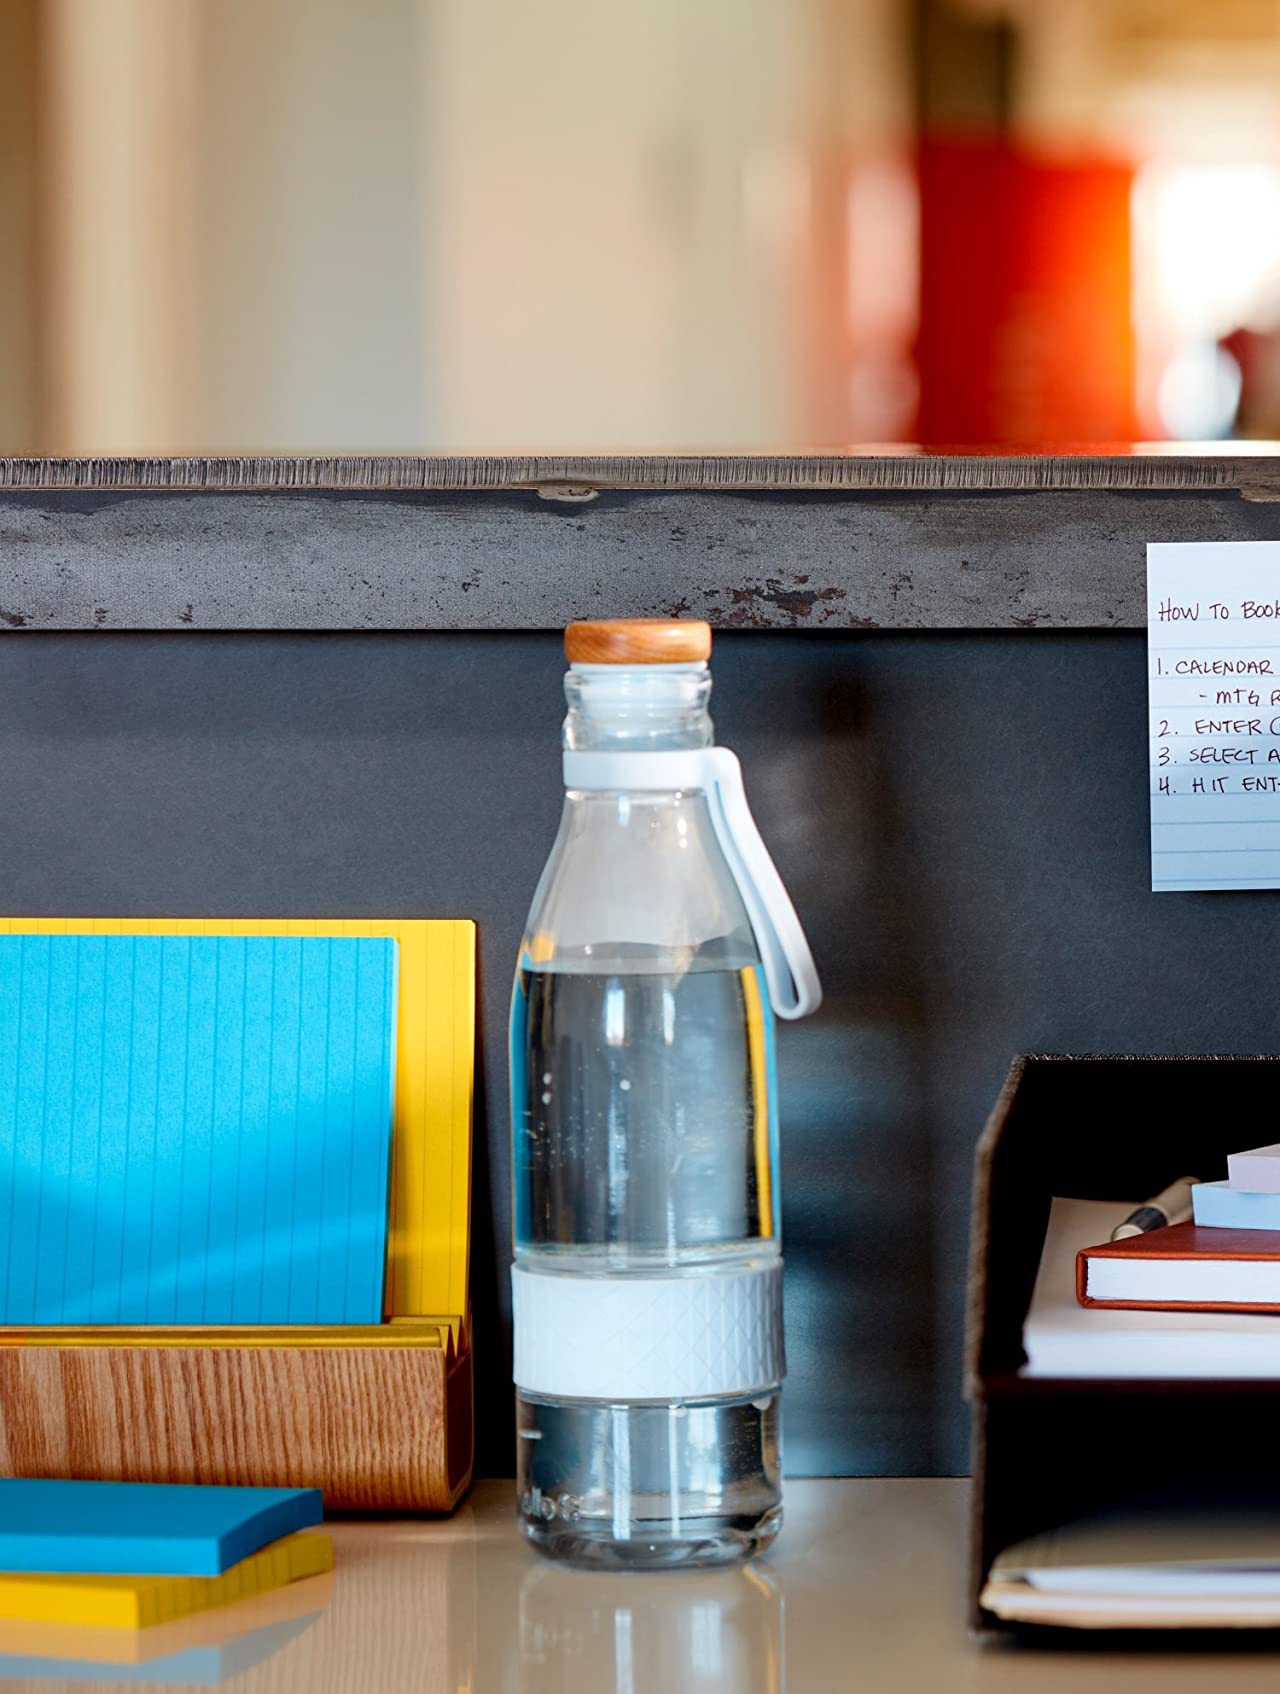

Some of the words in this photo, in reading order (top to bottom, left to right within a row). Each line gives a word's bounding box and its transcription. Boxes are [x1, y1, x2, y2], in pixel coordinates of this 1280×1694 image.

[1208, 603, 1230, 620] TO
[1157, 657, 1169, 676] 1.
[1175, 659, 1274, 676] CALENDAR
[1157, 719, 1179, 738] 2.
[1194, 718, 1263, 737] ENTER
[1158, 746, 1178, 767] 3.
[1188, 746, 1259, 766] SELECT
[1158, 775, 1177, 797] 4.
[1191, 776, 1230, 794] HIT
